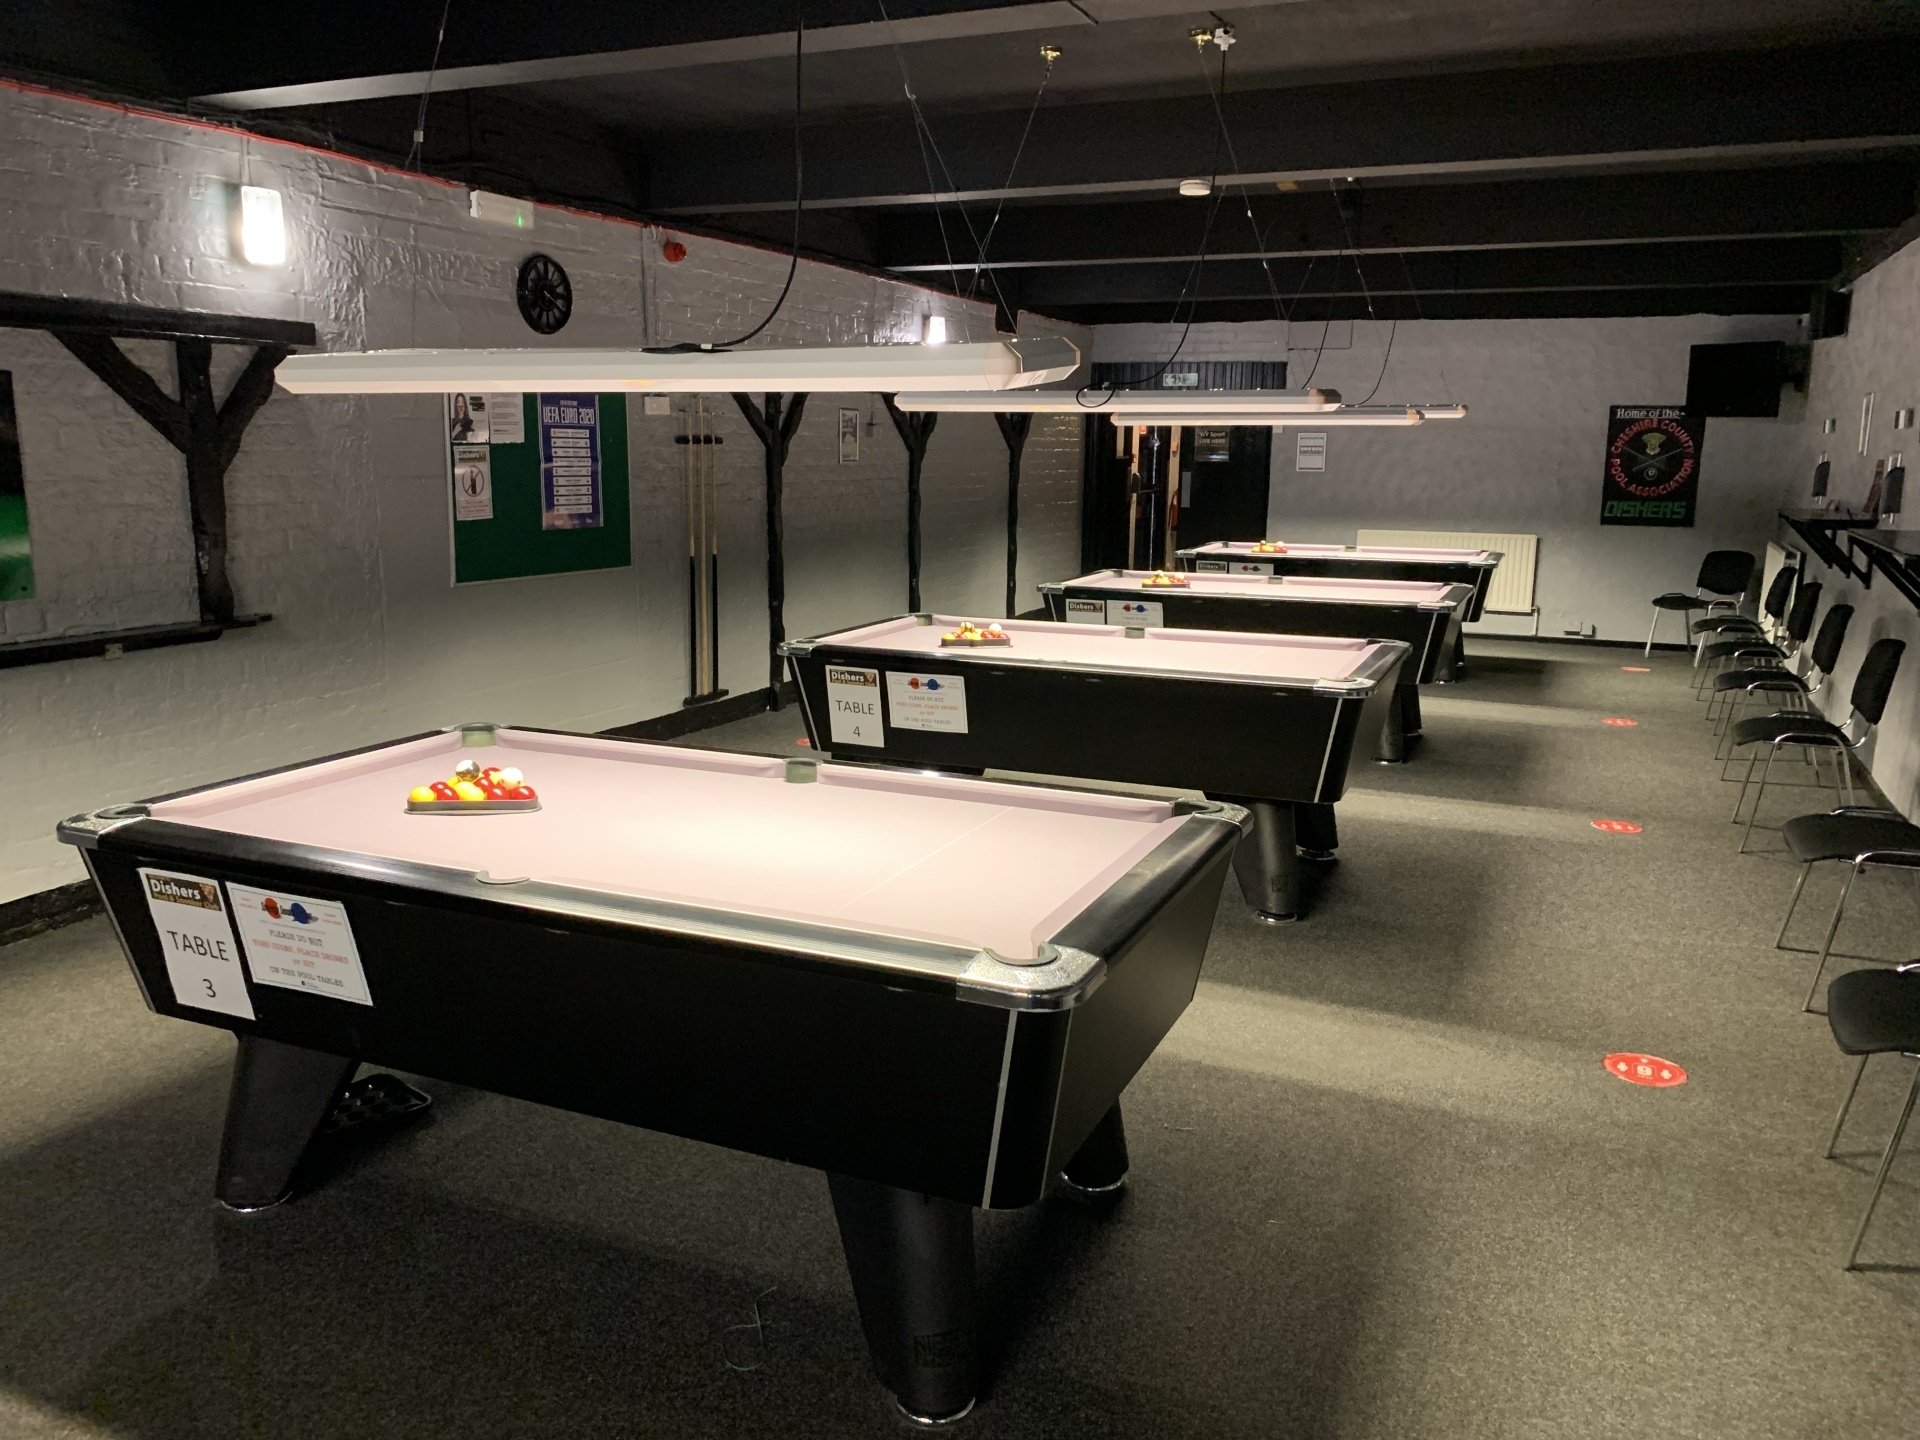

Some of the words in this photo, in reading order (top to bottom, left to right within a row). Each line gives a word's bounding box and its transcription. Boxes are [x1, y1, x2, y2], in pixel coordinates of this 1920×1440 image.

[542, 406, 560, 423] UEFA
[560, 407, 578, 424] EURO
[578, 408, 595, 424] 2020
[1617, 408, 1646, 418] Home
[1648, 408, 1660, 418] of
[1662, 408, 1679, 418] the
[1611, 418, 1659, 453] CHESHIRE
[1661, 420, 1694, 453] COUNTY
[1610, 458, 1628, 488] POOL
[1627, 458, 1694, 496] ASSOCIATION
[1604, 501, 1687, 518] DISHERS
[1069, 602, 1094, 610] Dishers
[831, 671, 864, 682] Dishers
[835, 700, 875, 715] TABLE
[853, 726, 861, 737] 4
[150, 879, 201, 900] Dishers
[166, 930, 230, 962] TABLE
[202, 978, 217, 998] 3
